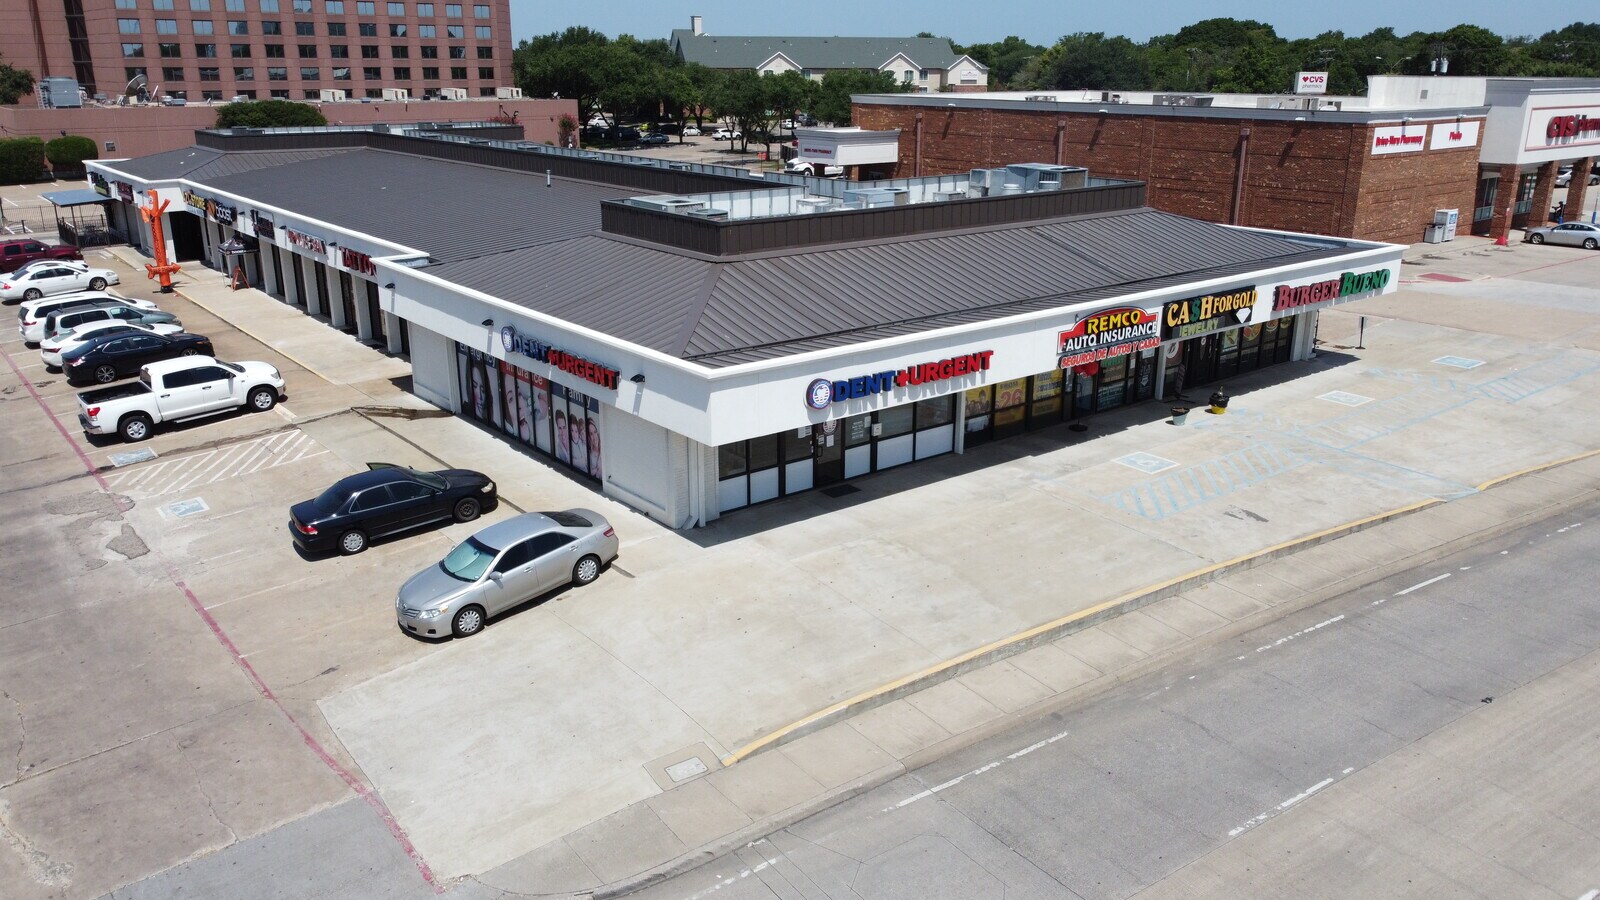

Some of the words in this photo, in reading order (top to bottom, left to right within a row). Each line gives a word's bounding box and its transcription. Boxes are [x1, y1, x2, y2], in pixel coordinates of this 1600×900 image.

[1401, 135, 1424, 145] Pharmacy
[1448, 131, 1462, 141] Photo
[1213, 294, 1233, 314] FOR
[1232, 289, 1259, 311] GOLD
[1273, 279, 1341, 311] BURGER
[1341, 268, 1391, 297] BUENO
[1086, 310, 1141, 335] REMCO
[1180, 318, 1219, 338] JEWELRY
[1065, 334, 1097, 352] AUTO
[1099, 321, 1158, 344] INSURANCE
[1061, 350, 1096, 369] SEGUROS
[1096, 347, 1108, 361] DE
[1107, 342, 1132, 358] AUTOS
